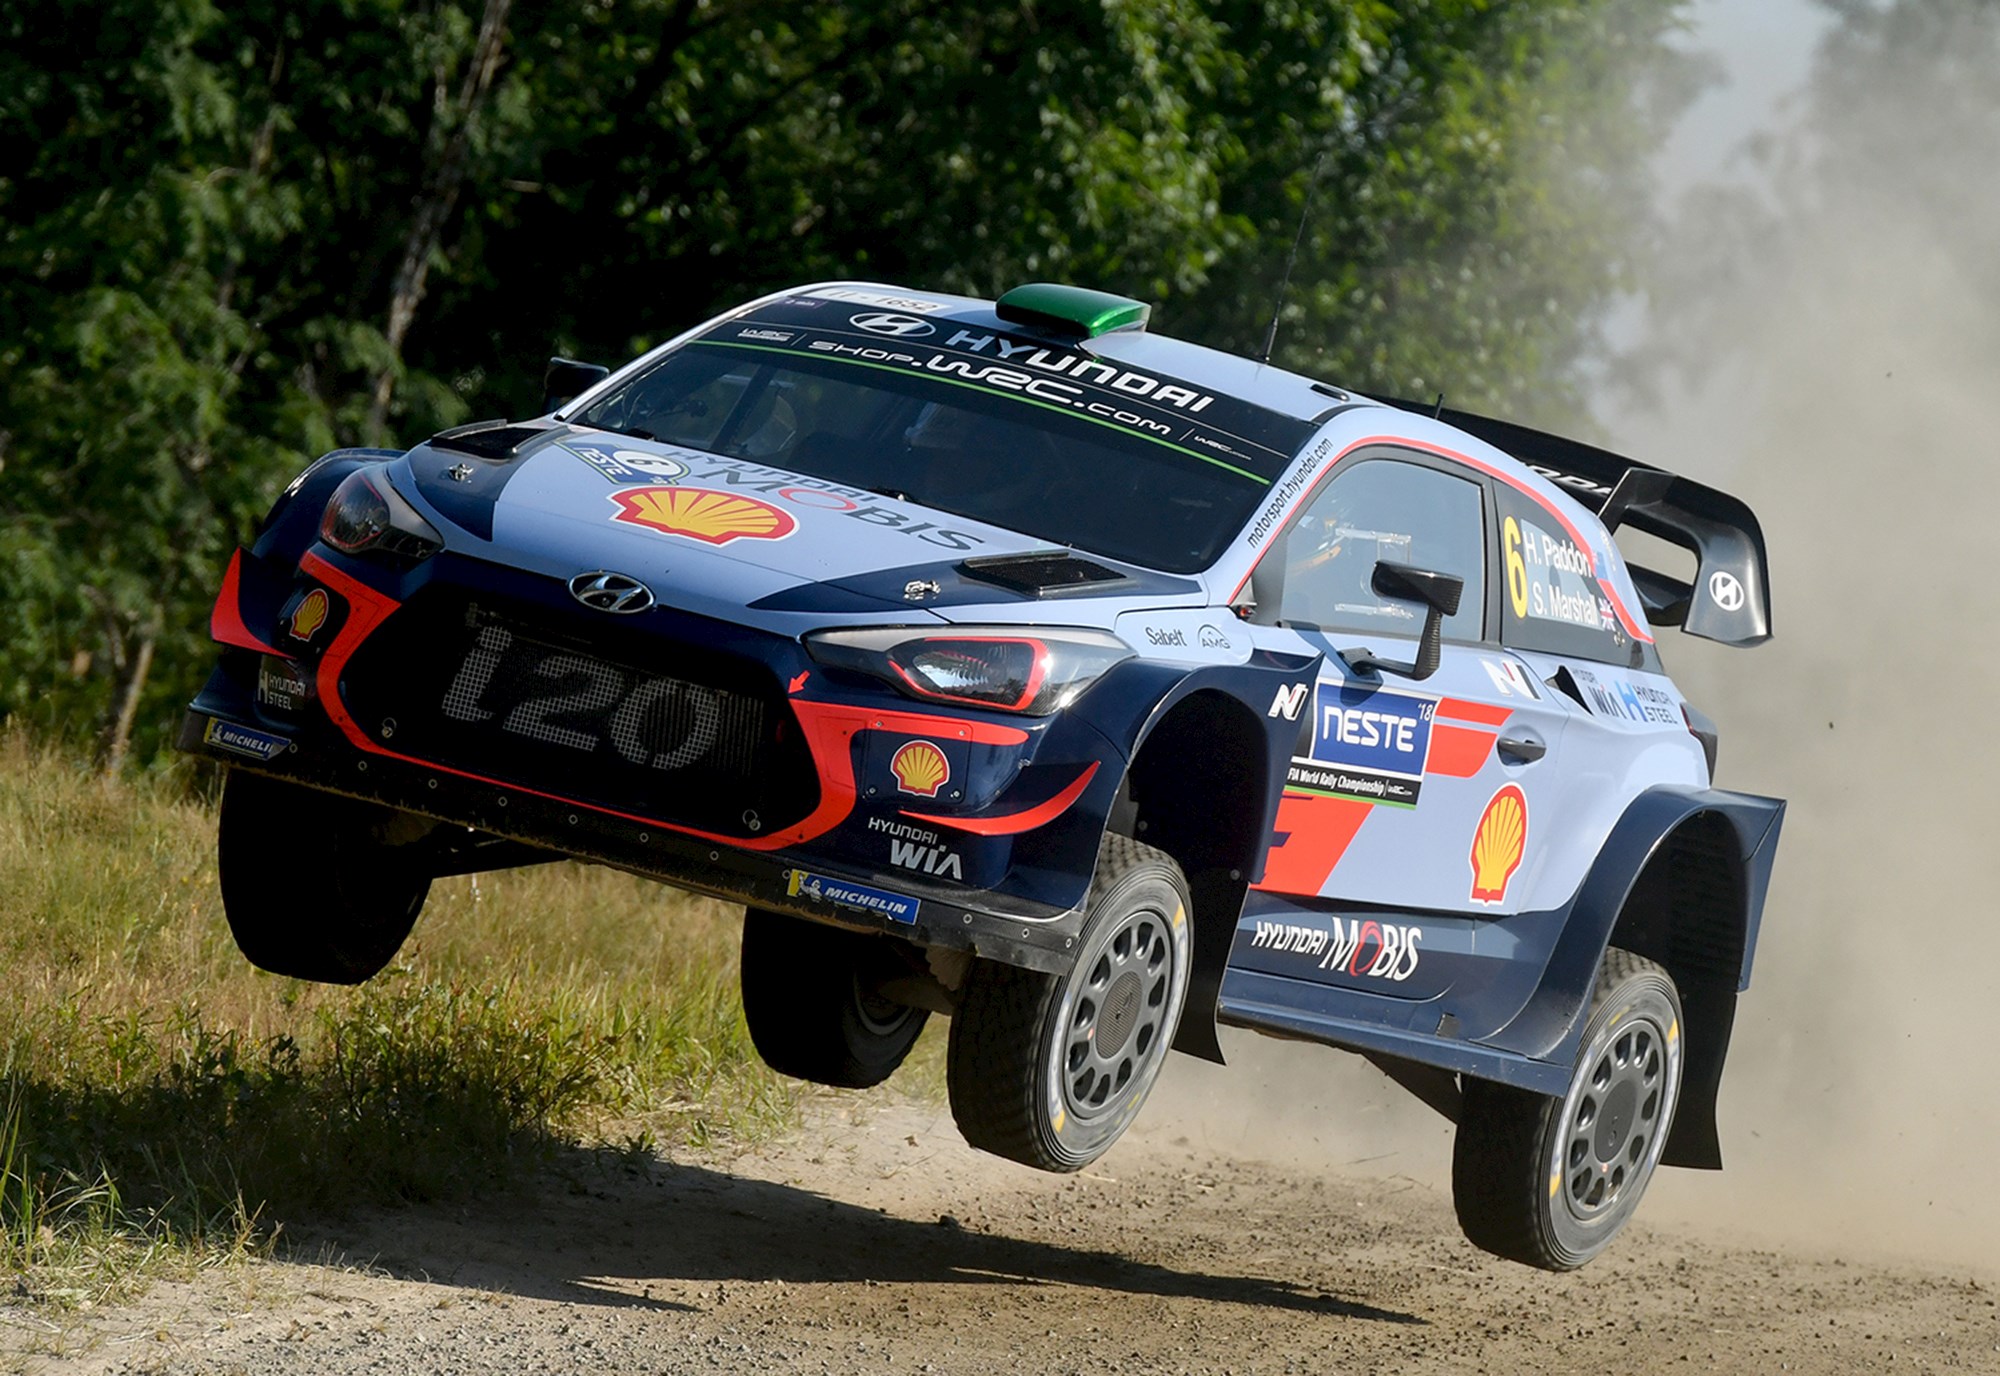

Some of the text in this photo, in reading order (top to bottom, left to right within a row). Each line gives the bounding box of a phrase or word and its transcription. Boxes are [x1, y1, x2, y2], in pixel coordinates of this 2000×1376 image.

[944, 329, 1217, 413] HYUNDAI
[664, 451, 880, 502] HYUNDAI
[1247, 438, 1334, 549] motorsport.hyundai.com
[694, 468, 986, 551] MOBIS
[1503, 516, 1528, 619] 6
[1522, 531, 1542, 566] H.
[1542, 534, 1593, 578] Paddon
[1532, 583, 1600, 626] S. Marshall
[1145, 626, 1188, 648] Sabelt
[268, 673, 307, 697] HYUNDAI
[268, 691, 292, 711] STEEL
[441, 624, 721, 771] i20
[1587, 684, 1628, 720] WIA
[1322, 705, 1418, 753] NESTE
[1643, 706, 1679, 724] STEEL
[1287, 767, 1300, 781] FIA
[1300, 769, 1320, 785] World
[1319, 772, 1337, 789] Rally
[1337, 775, 1384, 796] Championship
[868, 816, 938, 845] HYUNDAI
[890, 838, 963, 880] WIA
[825, 886, 908, 914] MICHELIN
[1251, 916, 1422, 981] HYUNDAI MOBIS
